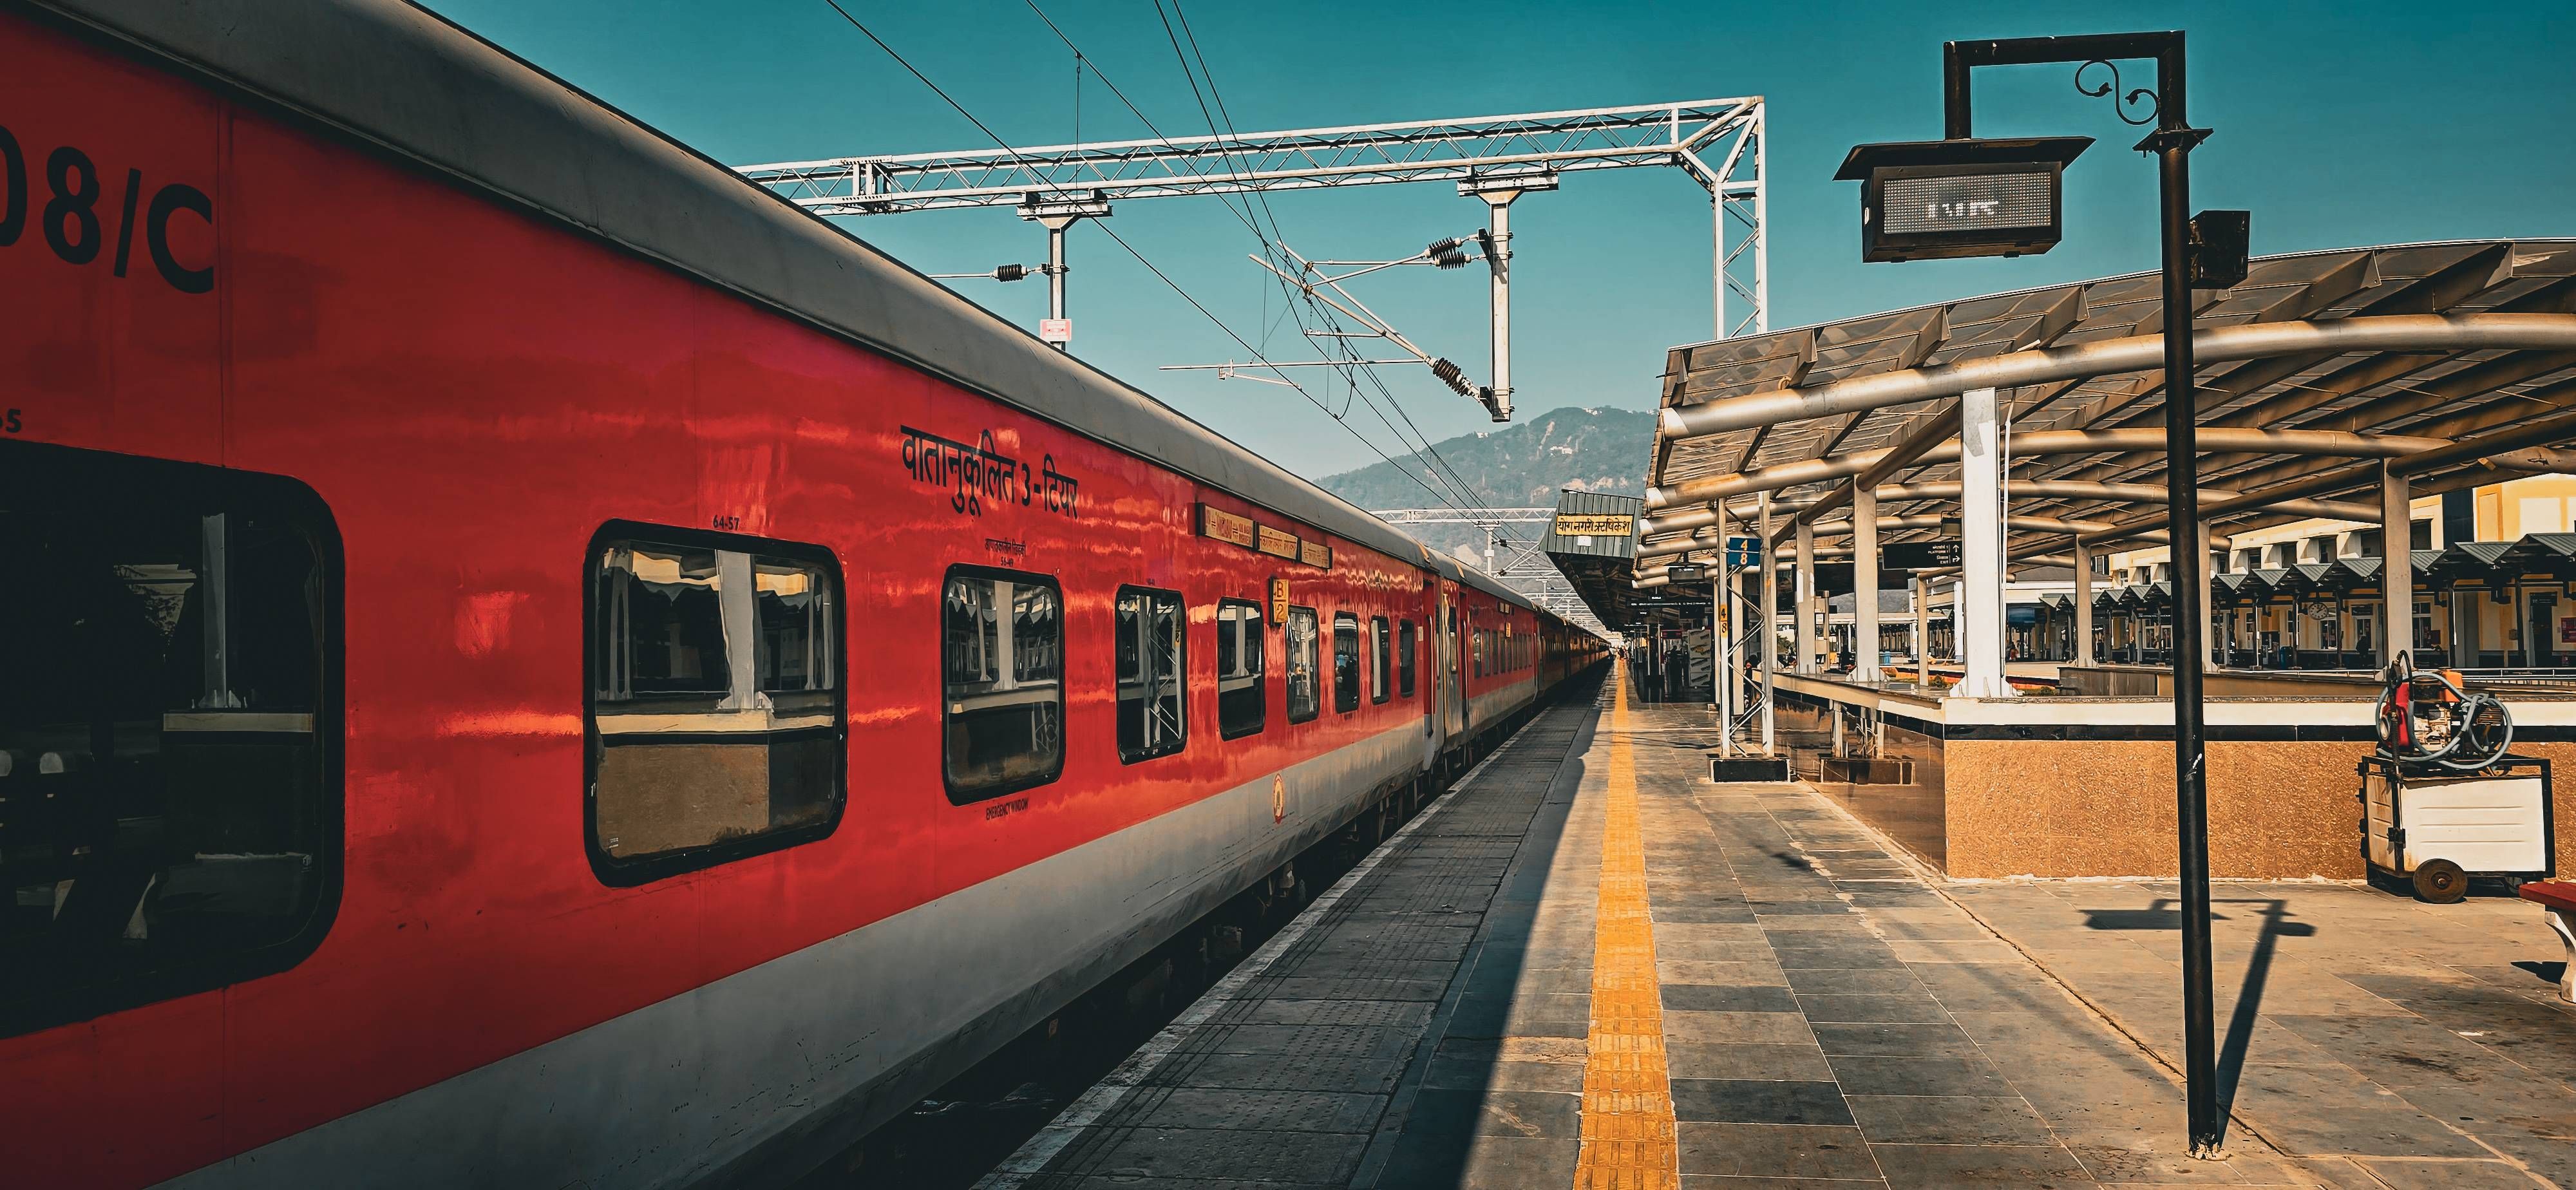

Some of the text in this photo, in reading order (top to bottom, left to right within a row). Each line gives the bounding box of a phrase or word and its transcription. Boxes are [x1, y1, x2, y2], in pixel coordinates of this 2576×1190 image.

[900, 424, 1016, 516] वातानुकूलित
[713, 515, 739, 531] 64-57
[1558, 518, 1573, 532] योग
[1574, 518, 1594, 532] नगरी
[1741, 539, 1747, 551] 4
[1740, 553, 1747, 565] 8
[1276, 581, 1283, 598] B
[1276, 603, 1284, 621] 2
[1721, 609, 1726, 619] 4
[1721, 623, 1727, 633] 8
[986, 802, 1010, 820] EMERGENCY
